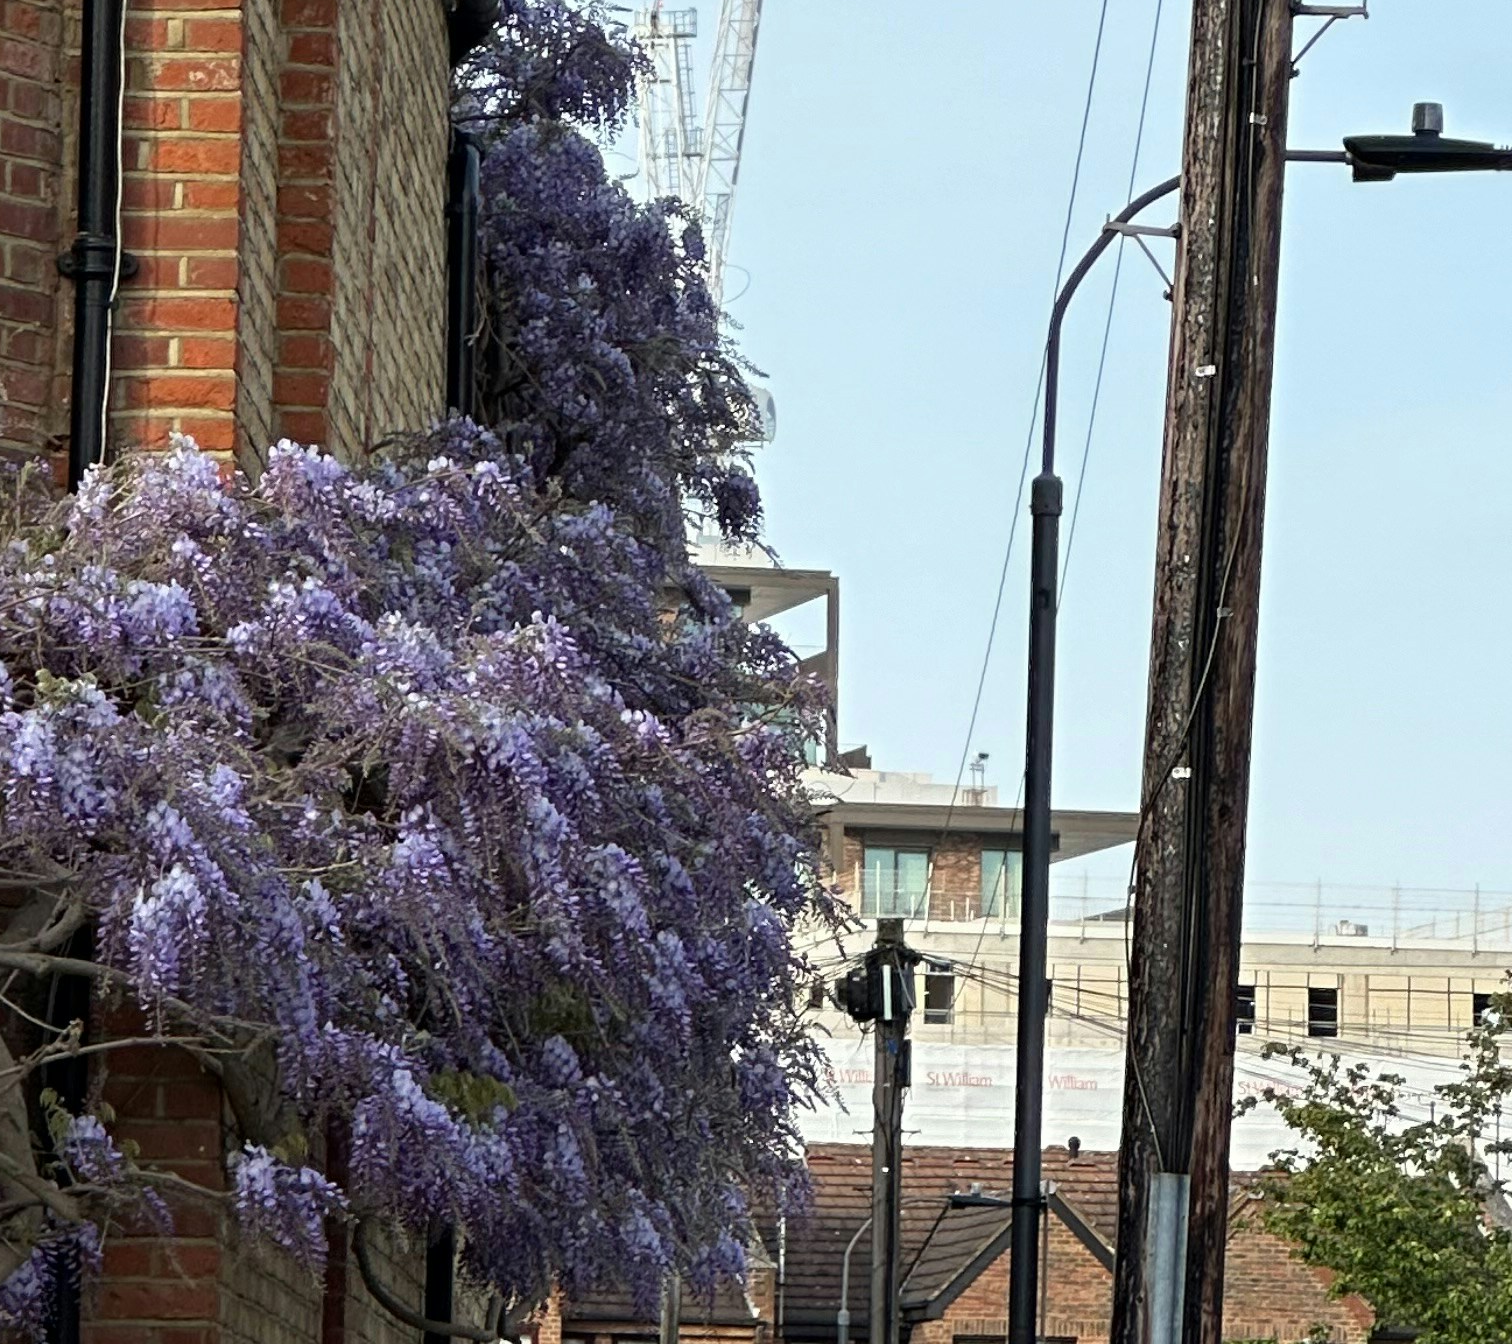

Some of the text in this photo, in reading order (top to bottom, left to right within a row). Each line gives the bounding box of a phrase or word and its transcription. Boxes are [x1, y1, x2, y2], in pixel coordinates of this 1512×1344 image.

[927, 1071, 993, 1088] St William
[1048, 1075, 1098, 1091] William
